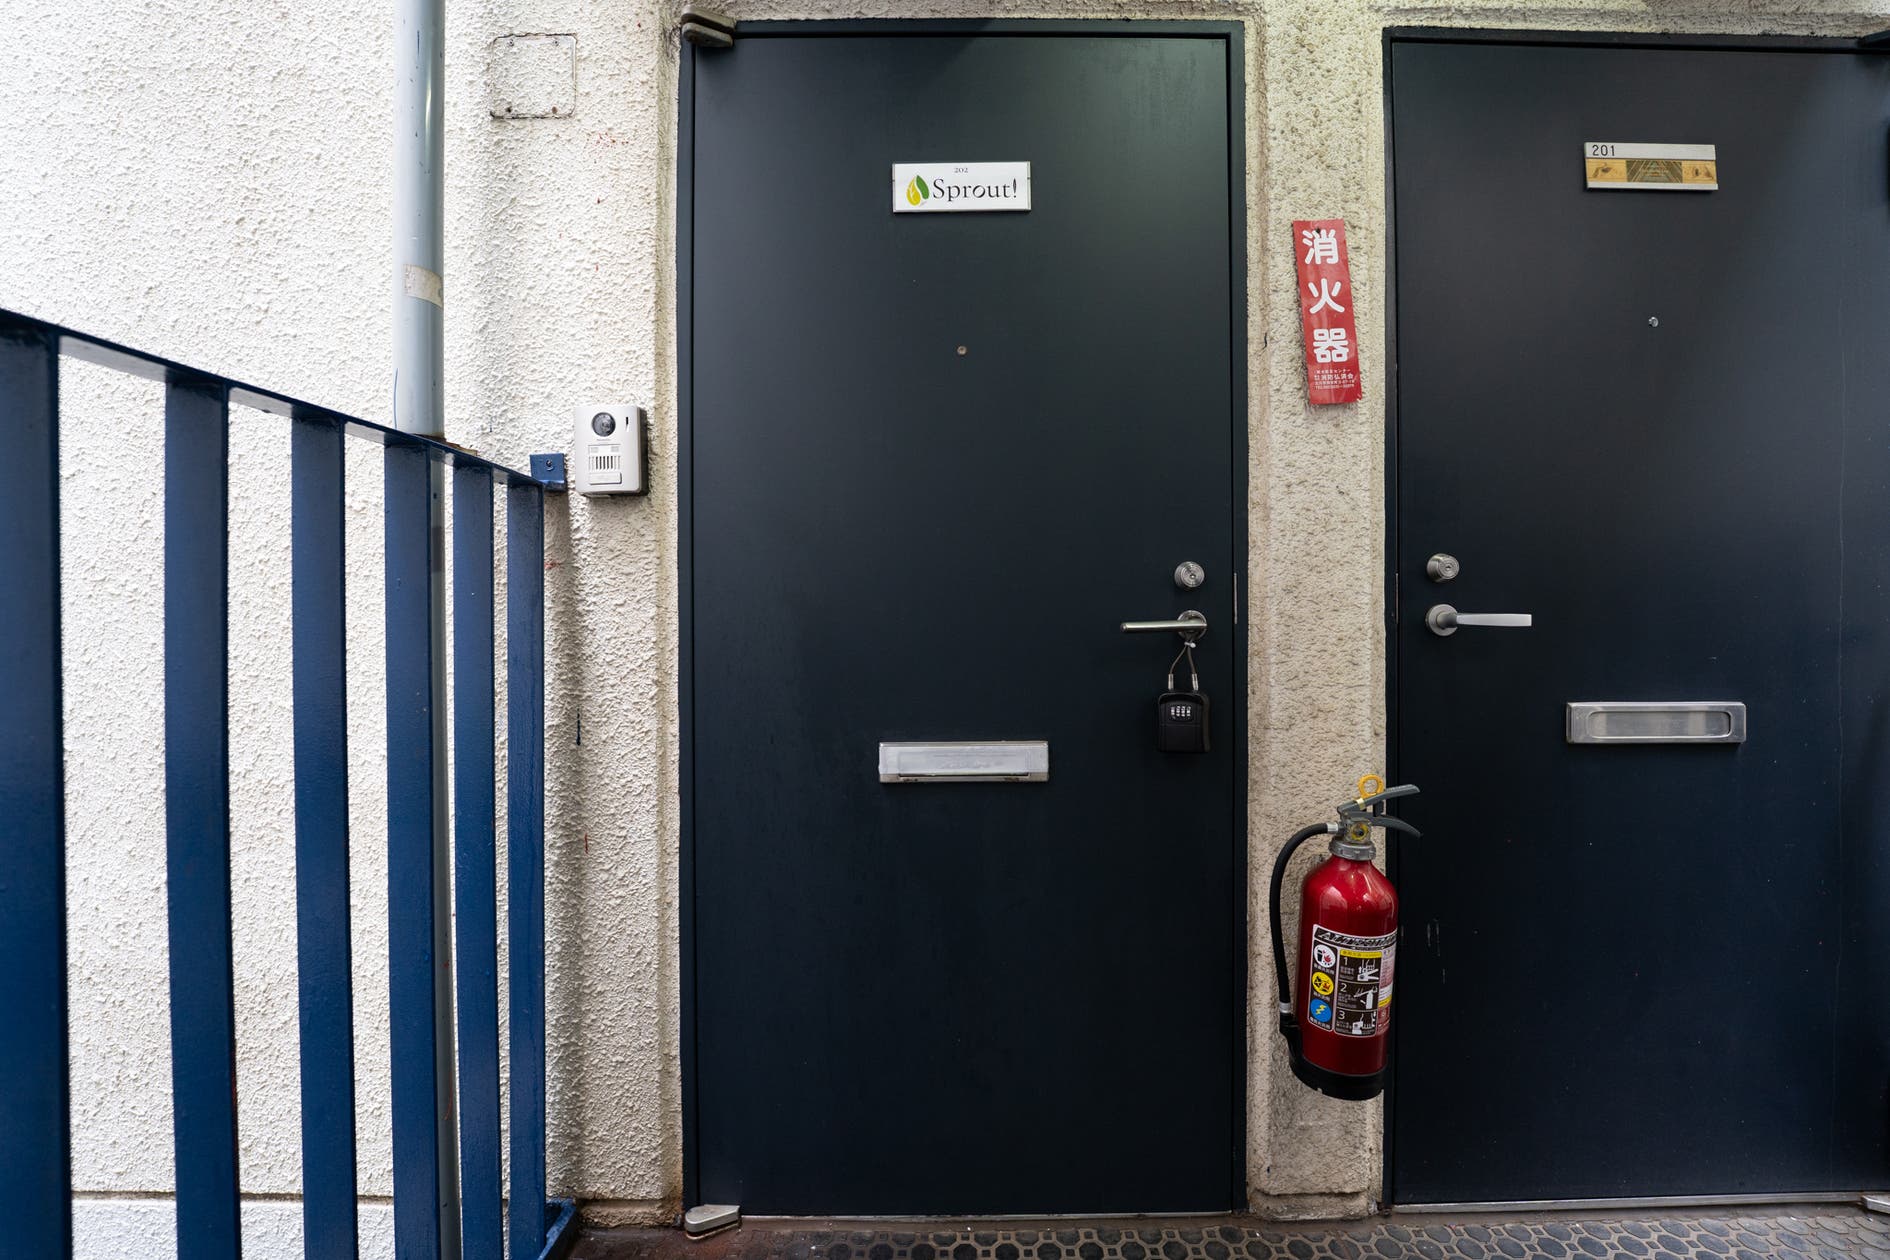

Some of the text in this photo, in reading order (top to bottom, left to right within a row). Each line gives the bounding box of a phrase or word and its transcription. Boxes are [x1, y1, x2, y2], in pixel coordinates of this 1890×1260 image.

[1592, 144, 1615, 156] 201
[932, 177, 1017, 202] Sprout!
[1302, 228, 1350, 363] 消火器
[1344, 956, 1348, 966] 1
[1340, 982, 1347, 992] 2
[1338, 1010, 1346, 1020] 3
